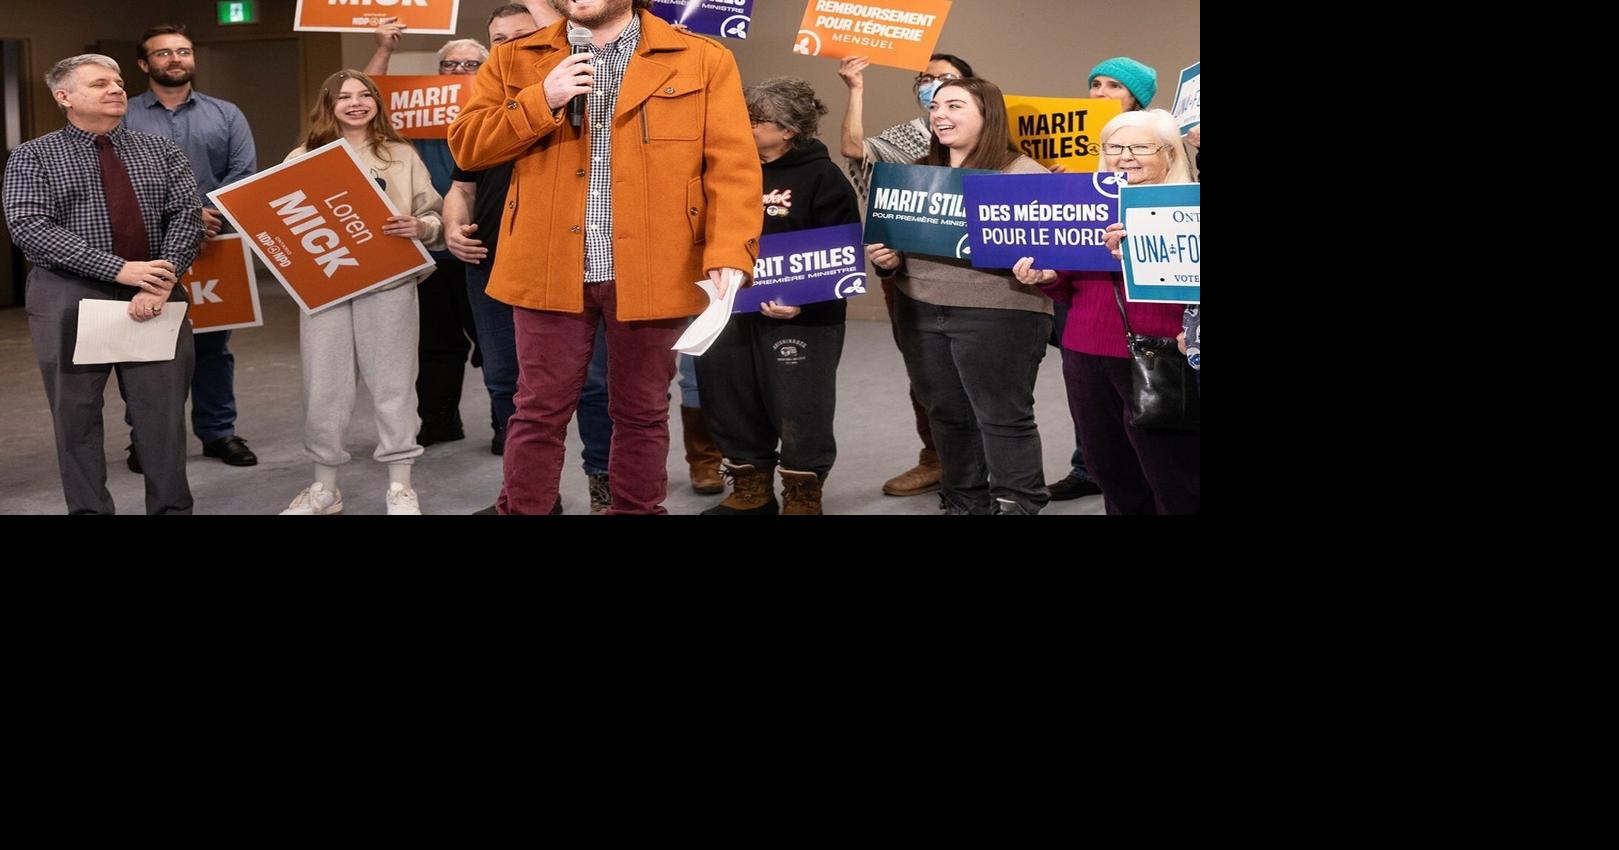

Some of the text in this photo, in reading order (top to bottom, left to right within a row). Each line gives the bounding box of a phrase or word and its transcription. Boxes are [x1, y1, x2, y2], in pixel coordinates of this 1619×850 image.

[701, 3, 744, 14] MINISTRE
[815, 0, 936, 27] REMBOURSEMENT
[815, 16, 924, 42] POUR L'ÉPICERIE
[831, 33, 894, 50] MENSUEL
[390, 83, 461, 111] MARIT
[391, 105, 460, 130] STILES
[1018, 110, 1088, 136] MARIT
[1020, 135, 1089, 159] STILES
[874, 187, 928, 213] MARIT
[978, 200, 1109, 222] DES MÉDECINS
[324, 190, 374, 245] Loren
[872, 211, 894, 220] POUR
[895, 214, 939, 225] PREMIÈRE
[268, 189, 360, 278] MICK
[982, 227, 1106, 246] POUR LE NORD
[255, 231, 292, 268] NDP NPD
[789, 246, 856, 274] STILES
[1176, 234, 1200, 264] FO
[807, 266, 857, 279] MINISTRE
